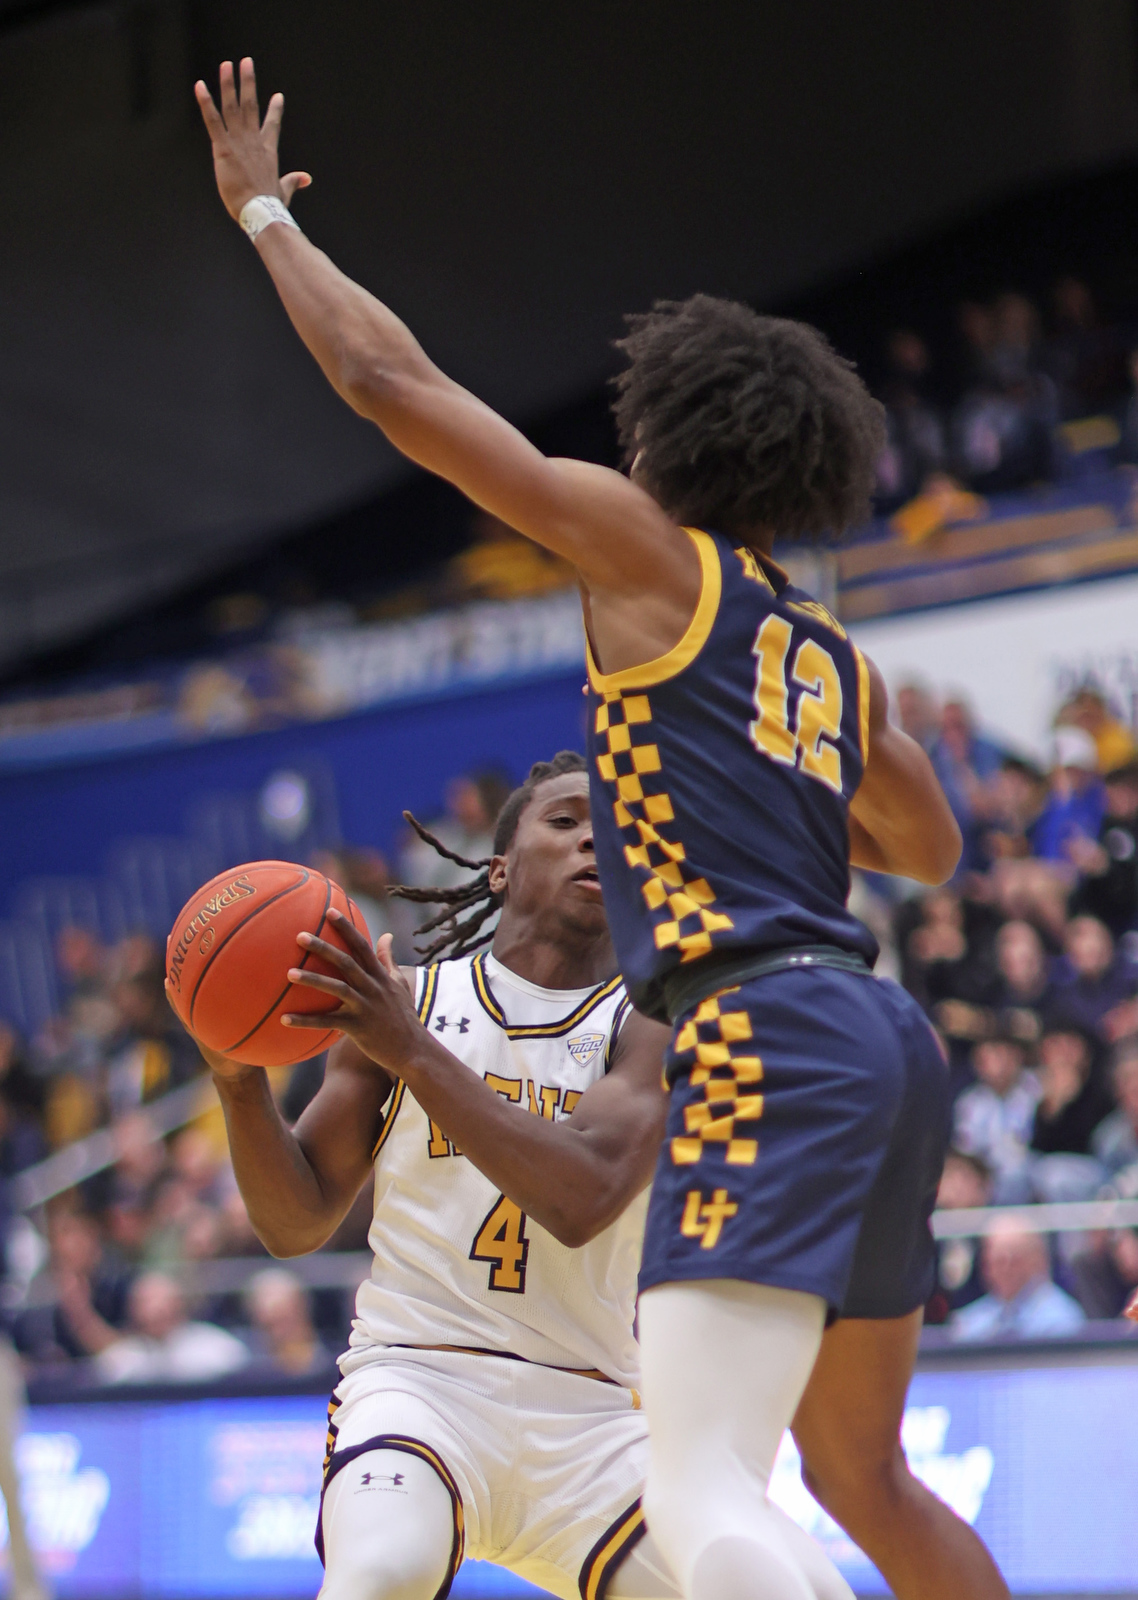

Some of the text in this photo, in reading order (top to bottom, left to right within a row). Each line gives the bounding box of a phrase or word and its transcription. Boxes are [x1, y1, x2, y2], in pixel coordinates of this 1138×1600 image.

[749, 612, 843, 794] 12
[168, 874, 257, 993] SPALDING
[570, 1041, 602, 1053] MAC
[469, 1192, 530, 1294] 4
